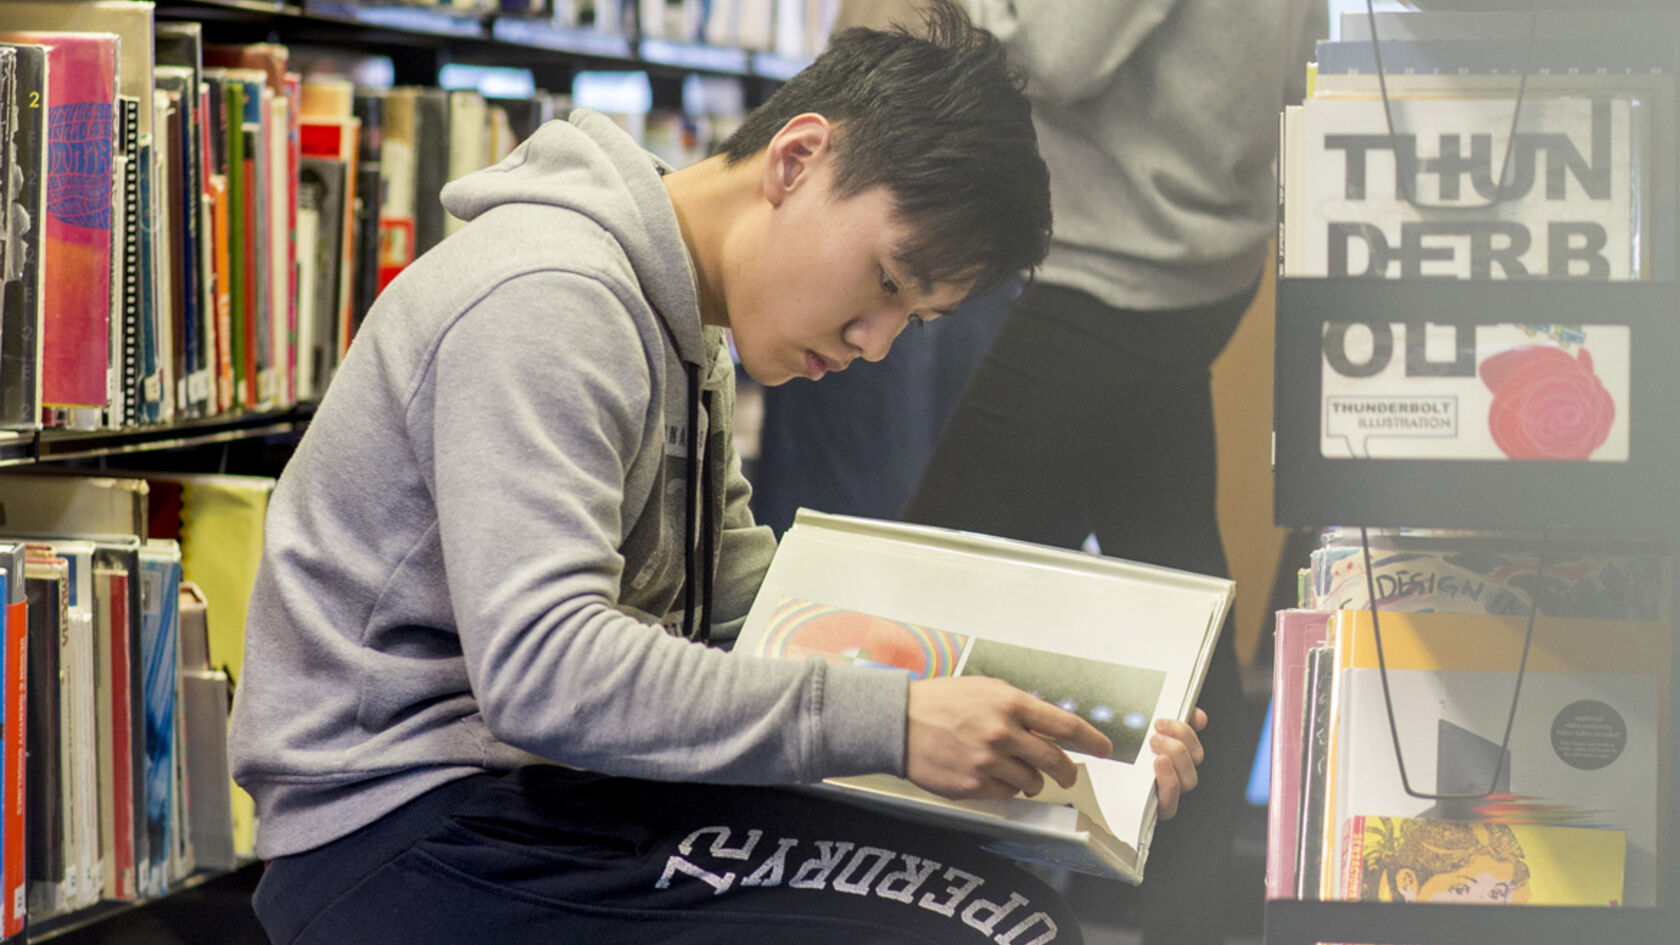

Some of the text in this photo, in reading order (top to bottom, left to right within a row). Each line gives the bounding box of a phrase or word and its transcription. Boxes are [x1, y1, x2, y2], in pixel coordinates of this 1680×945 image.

[29, 91, 40, 108] 2
[1324, 96, 1612, 201] THUN
[1327, 221, 1611, 280] DERB
[1332, 402, 1451, 414] THUNDERBOLT
[1358, 417, 1451, 429] ILLUSTRATION
[1376, 570, 1484, 602] DESIGN
